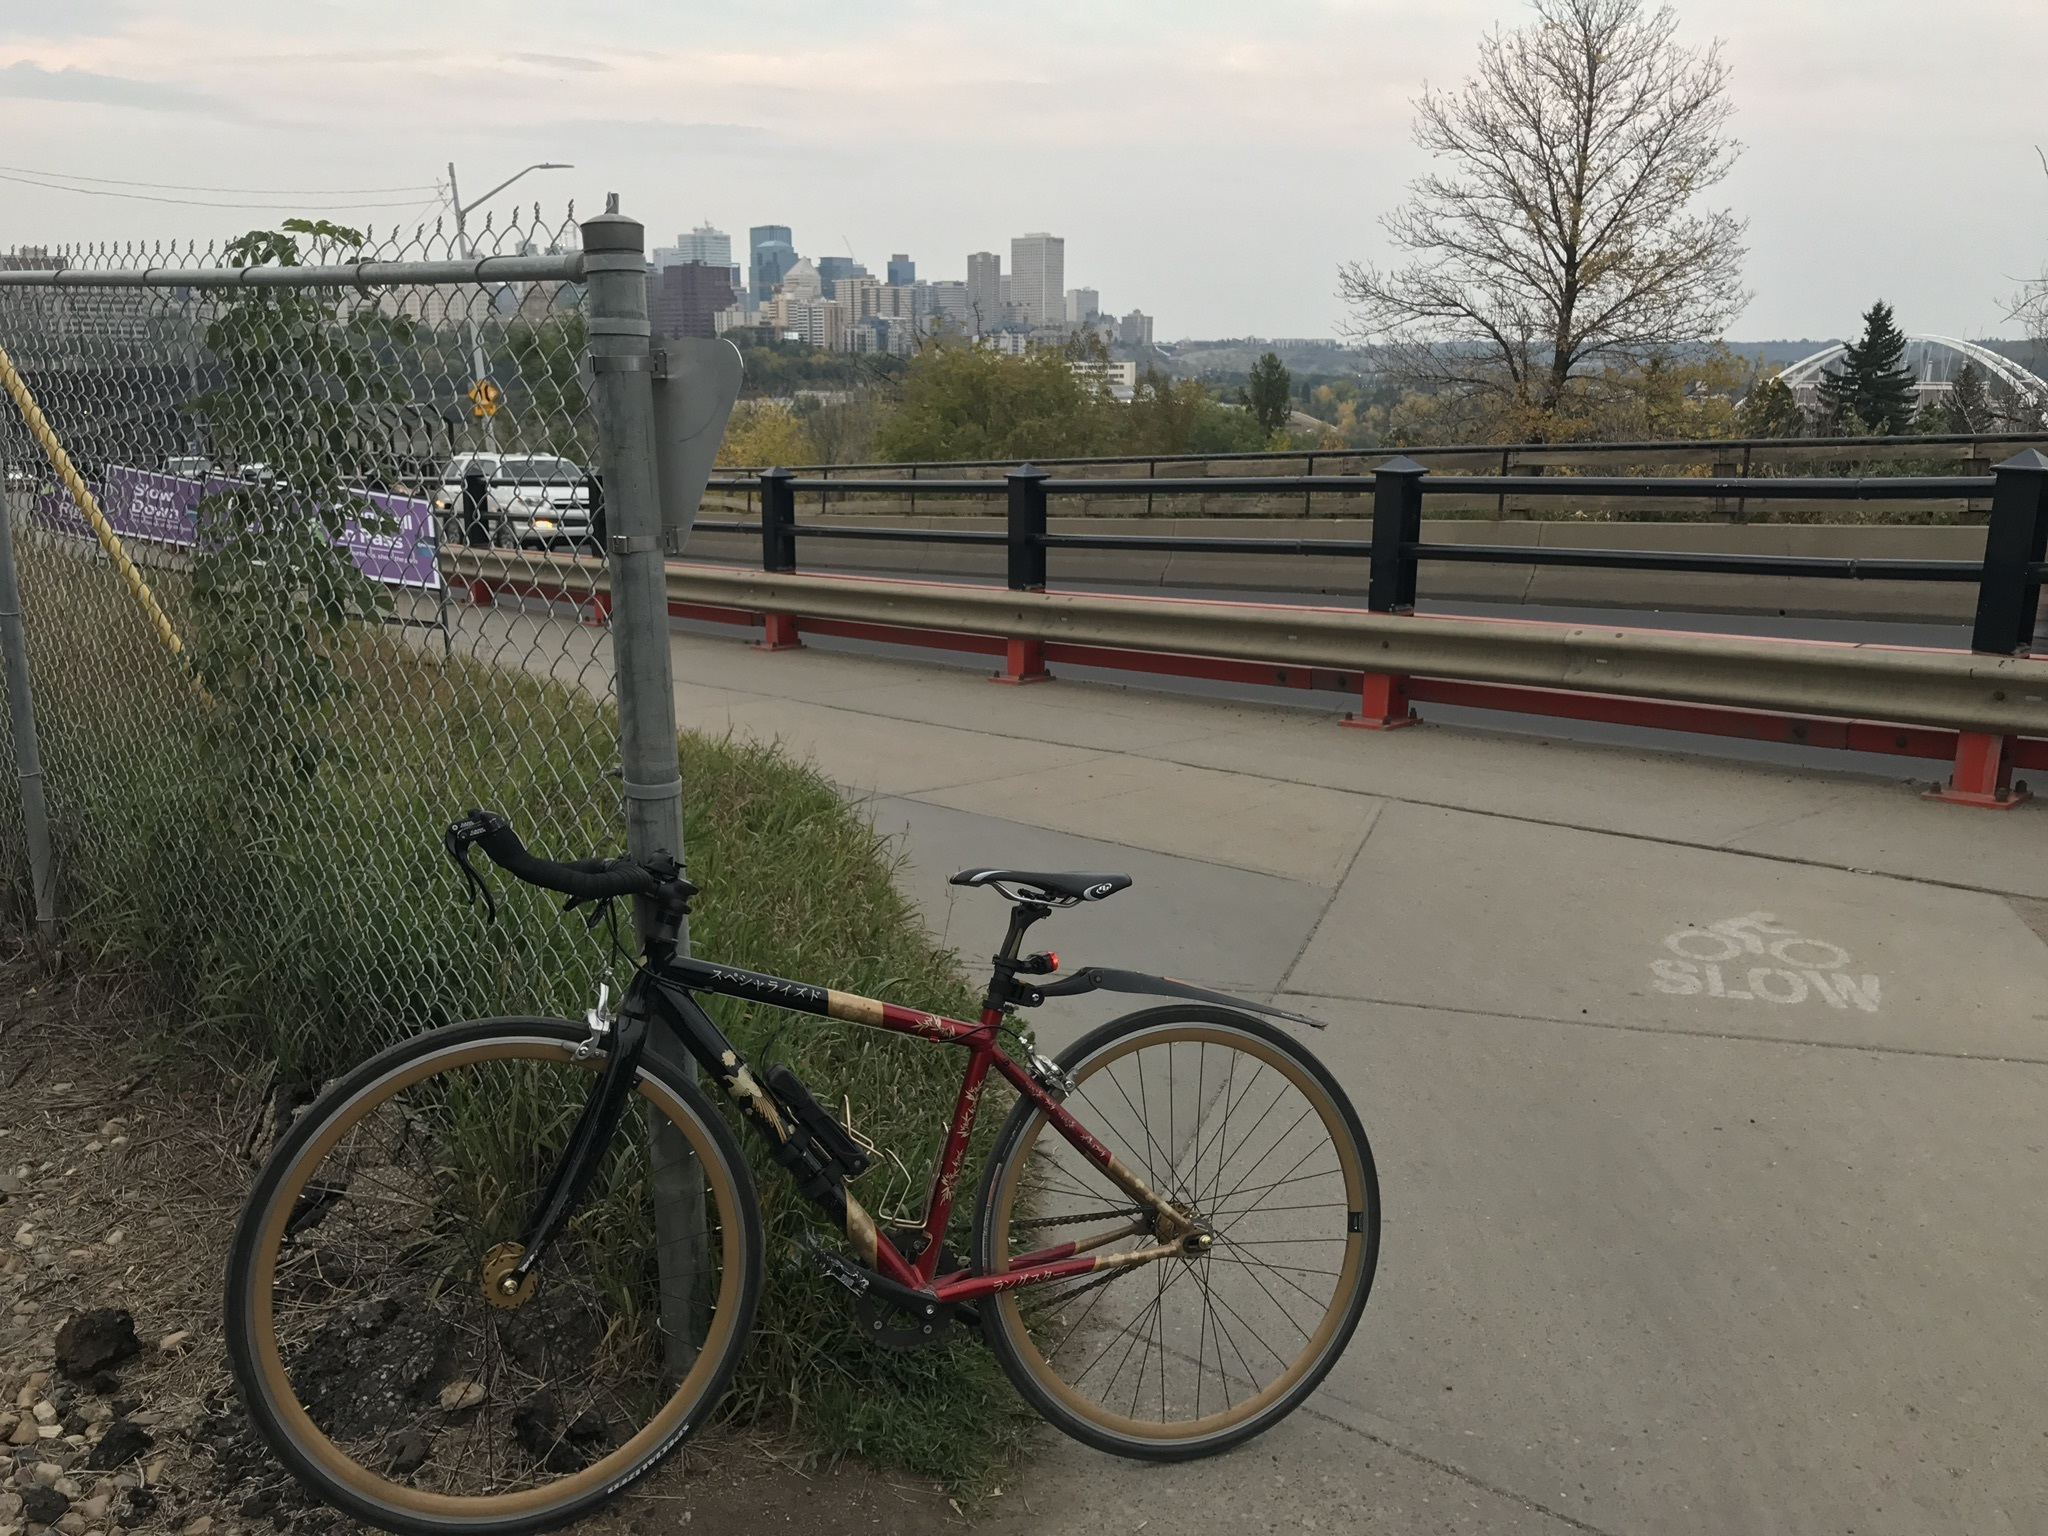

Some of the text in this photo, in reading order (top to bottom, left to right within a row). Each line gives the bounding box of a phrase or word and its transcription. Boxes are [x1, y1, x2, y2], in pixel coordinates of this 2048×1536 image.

[359, 527, 404, 549] Pass
[710, 969, 821, 1002] スペシャライズド
[1648, 958, 1882, 1013] SLOW
[992, 1270, 1066, 1293] ラングスター
[607, 1422, 690, 1494] SPECIALIZED
